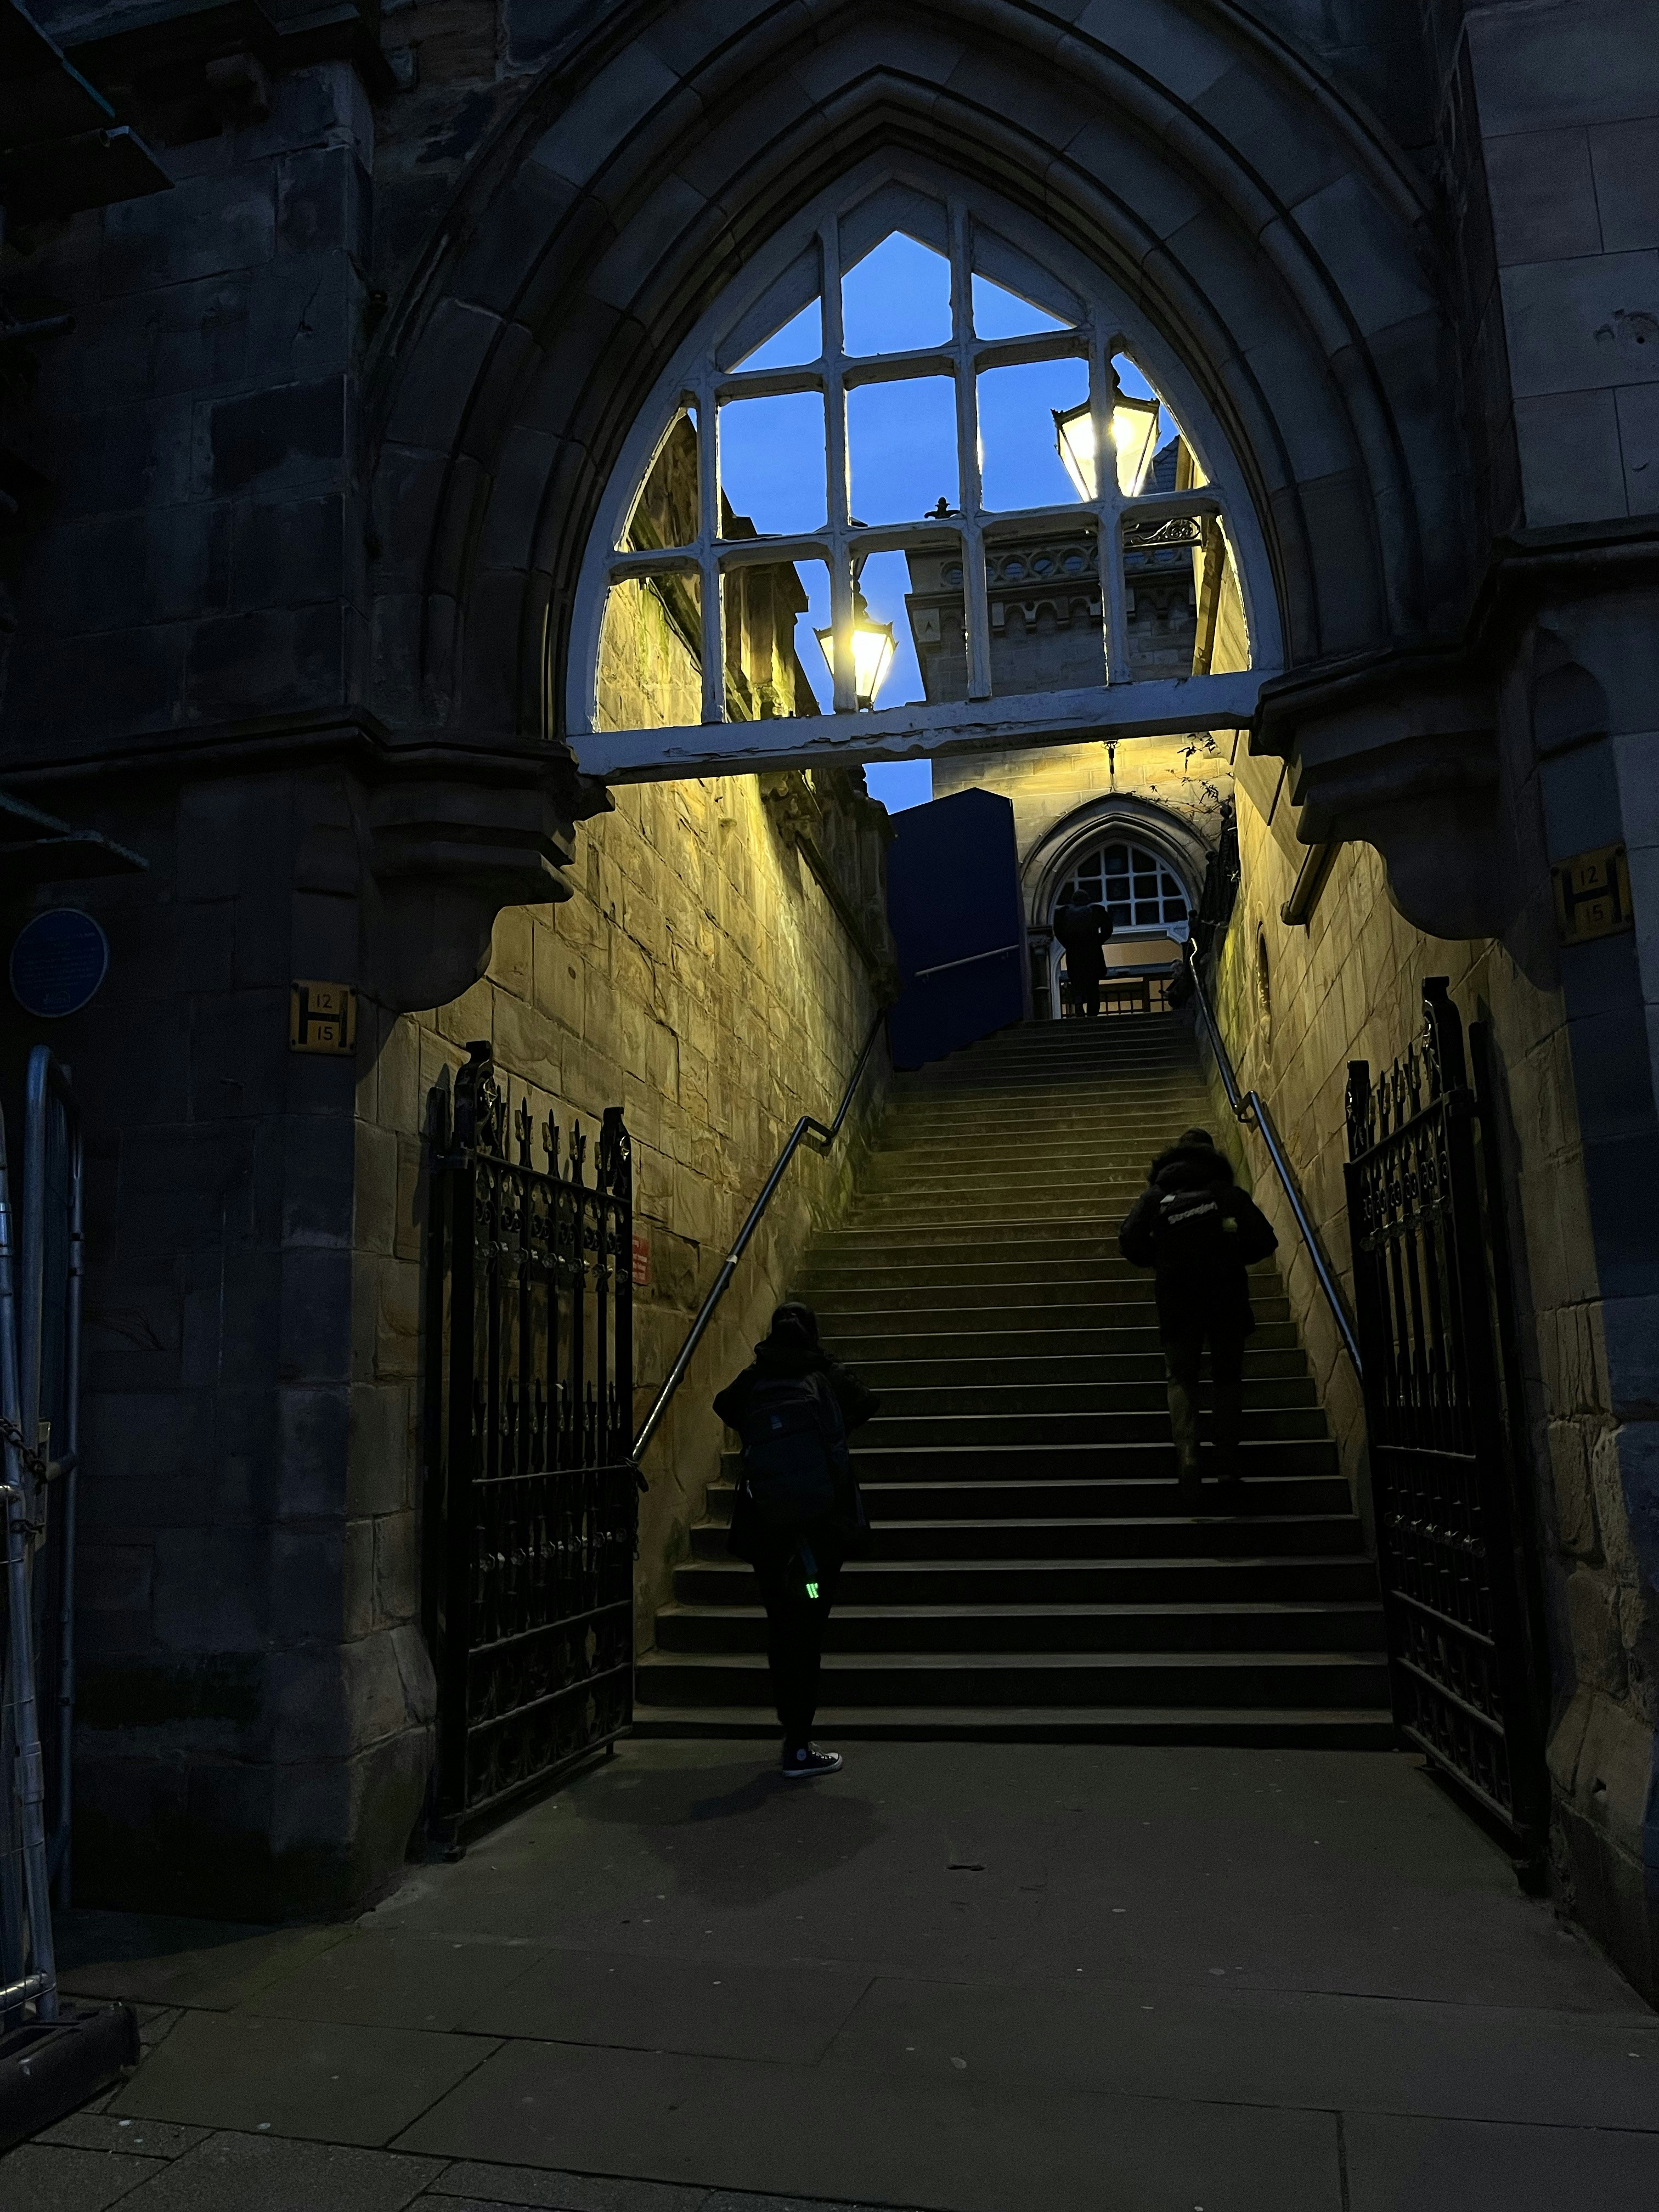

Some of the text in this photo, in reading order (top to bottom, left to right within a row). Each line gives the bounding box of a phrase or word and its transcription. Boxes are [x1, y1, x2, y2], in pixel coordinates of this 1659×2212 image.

[1581, 866, 1599, 886] 12
[1562, 857, 1622, 934] H
[1585, 904, 1604, 922] 15
[317, 994, 332, 1008] 12
[298, 986, 348, 1048] H
[318, 1026, 333, 1041] 15
